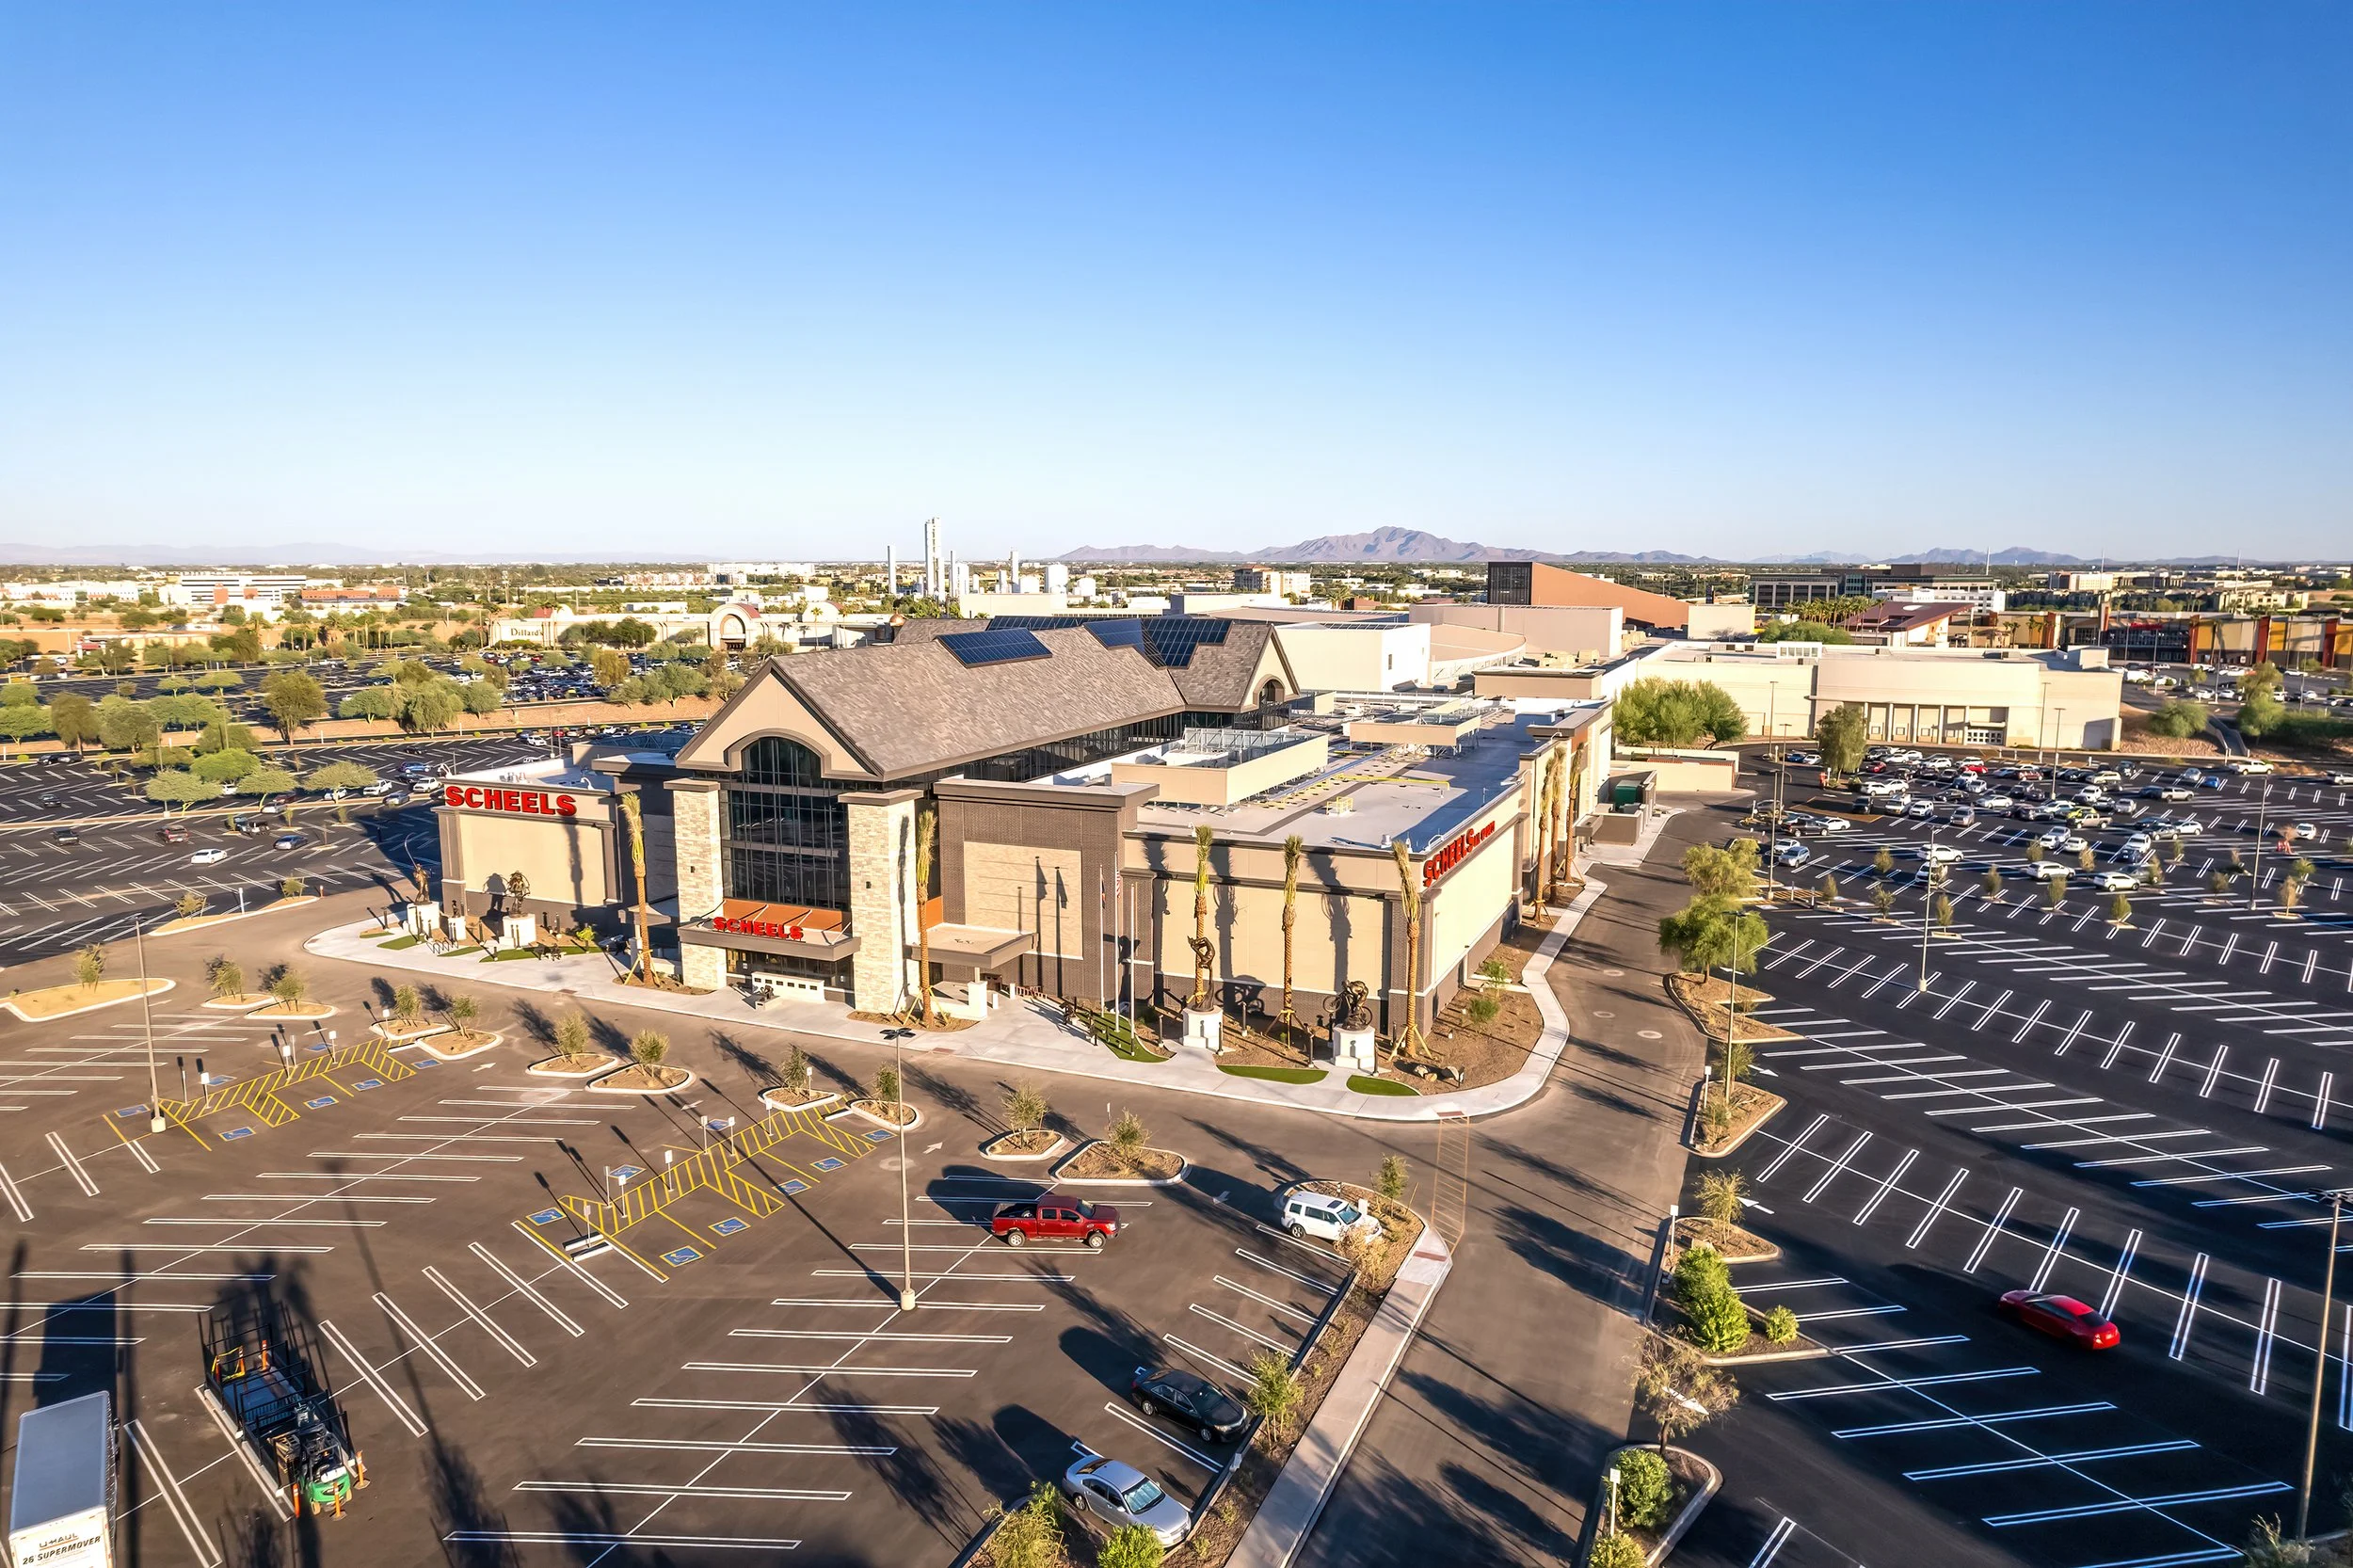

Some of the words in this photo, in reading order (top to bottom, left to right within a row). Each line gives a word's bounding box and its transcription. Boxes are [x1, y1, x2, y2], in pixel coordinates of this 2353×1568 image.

[445, 786, 577, 817] SCHEELS
[1422, 828, 1475, 888] SCHEELS
[712, 917, 804, 939] SCHEELS
[38, 1535, 101, 1561] SUPERMOVER
